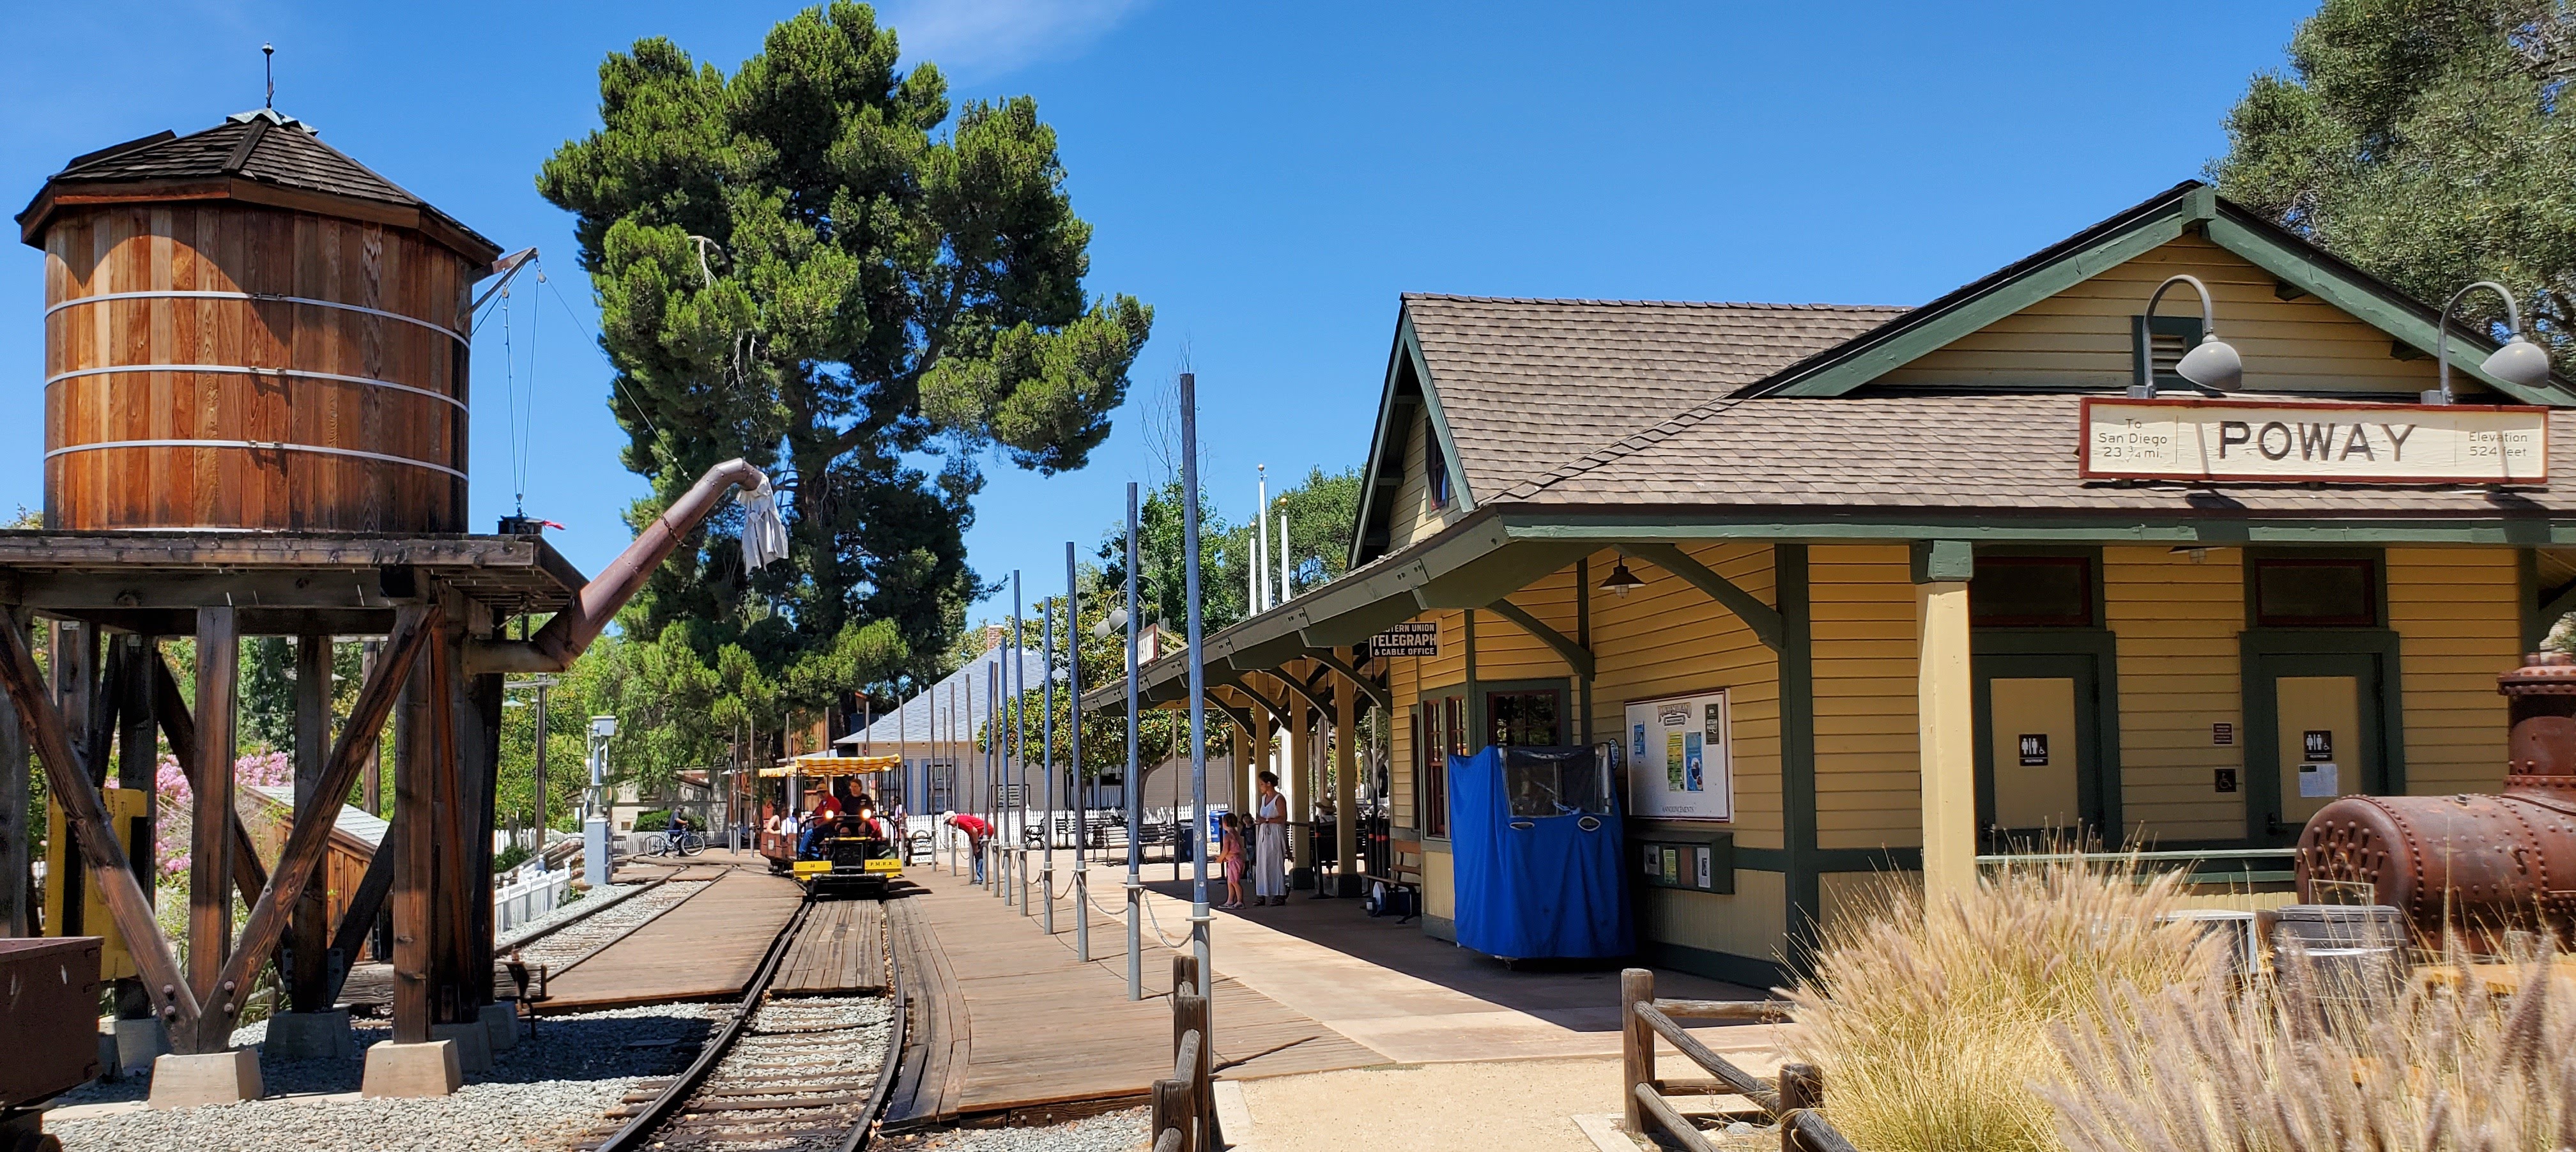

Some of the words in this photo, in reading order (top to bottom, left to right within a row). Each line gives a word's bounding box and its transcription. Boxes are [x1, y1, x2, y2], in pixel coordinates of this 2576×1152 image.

[2125, 419, 2142, 429] To
[2098, 433, 2124, 443] San
[2129, 433, 2168, 447] Diego
[2219, 420, 2418, 461] POWAY
[2469, 431, 2528, 442] Elevation
[2104, 447, 2122, 457] 23
[2144, 448, 2163, 458] mi.
[2469, 446, 2497, 456] 524
[2503, 446, 2527, 456] feet
[1372, 633, 1437, 647] TELEGRAPH
